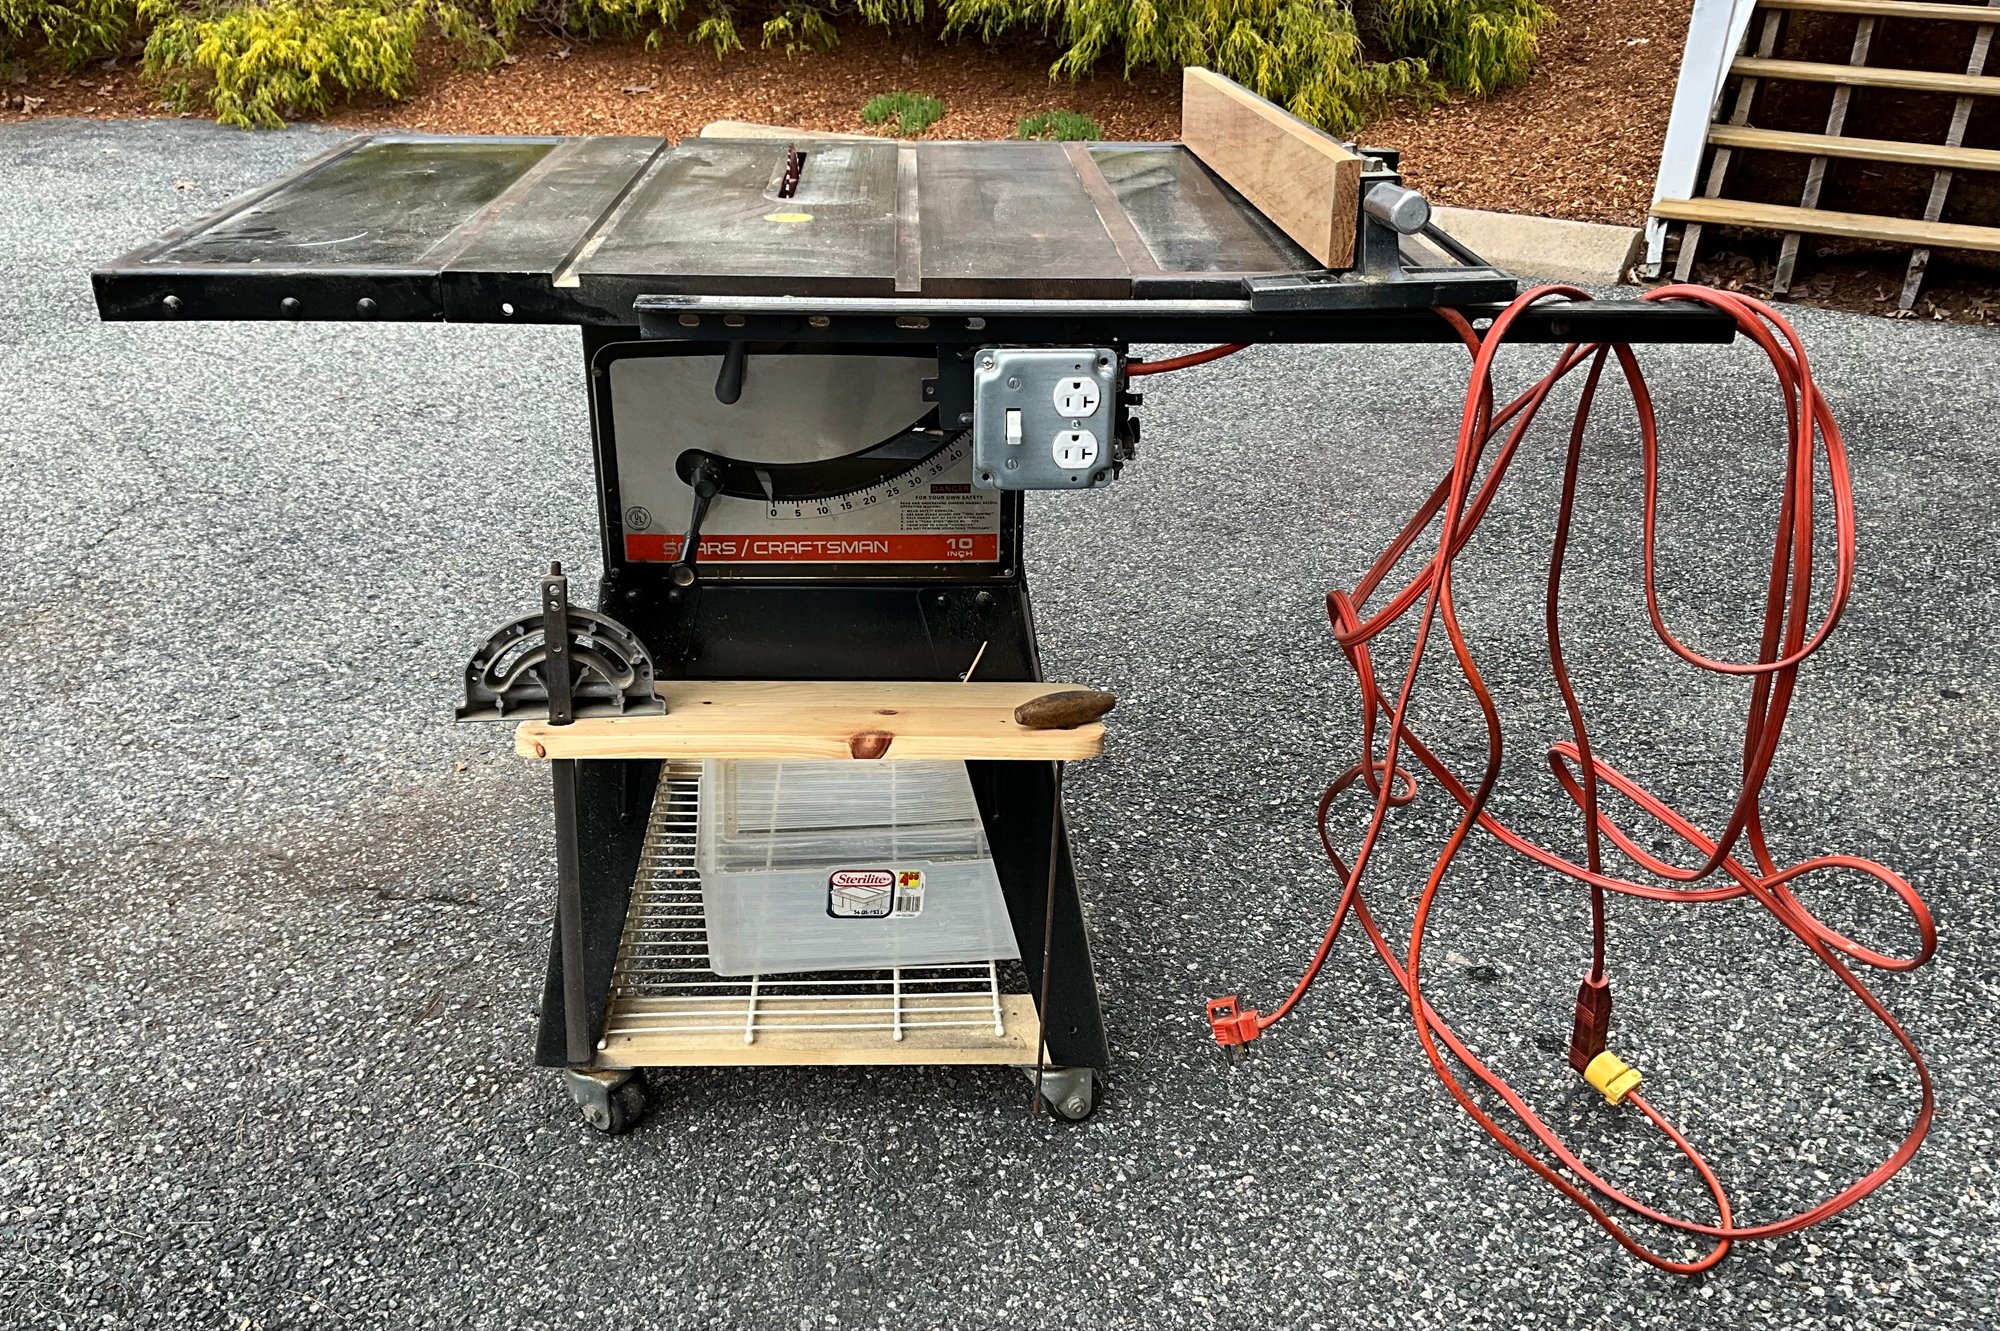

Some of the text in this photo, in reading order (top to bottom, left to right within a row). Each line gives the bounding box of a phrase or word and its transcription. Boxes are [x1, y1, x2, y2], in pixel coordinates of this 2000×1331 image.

[950, 450, 963, 462] 40
[929, 464, 943, 476] 35
[907, 477, 922, 488] 30
[886, 487, 900, 498] 25
[932, 485, 970, 493] DANGER
[840, 501, 853, 511] 15
[863, 495, 877, 506] 20
[770, 509, 777, 517] 0
[795, 509, 801, 517] 5
[816, 506, 829, 515] 10
[663, 541, 736, 555] SARS
[753, 541, 889, 554] CRAFTSMAN
[946, 538, 973, 549] 10
[837, 874, 887, 884] Sterilite
